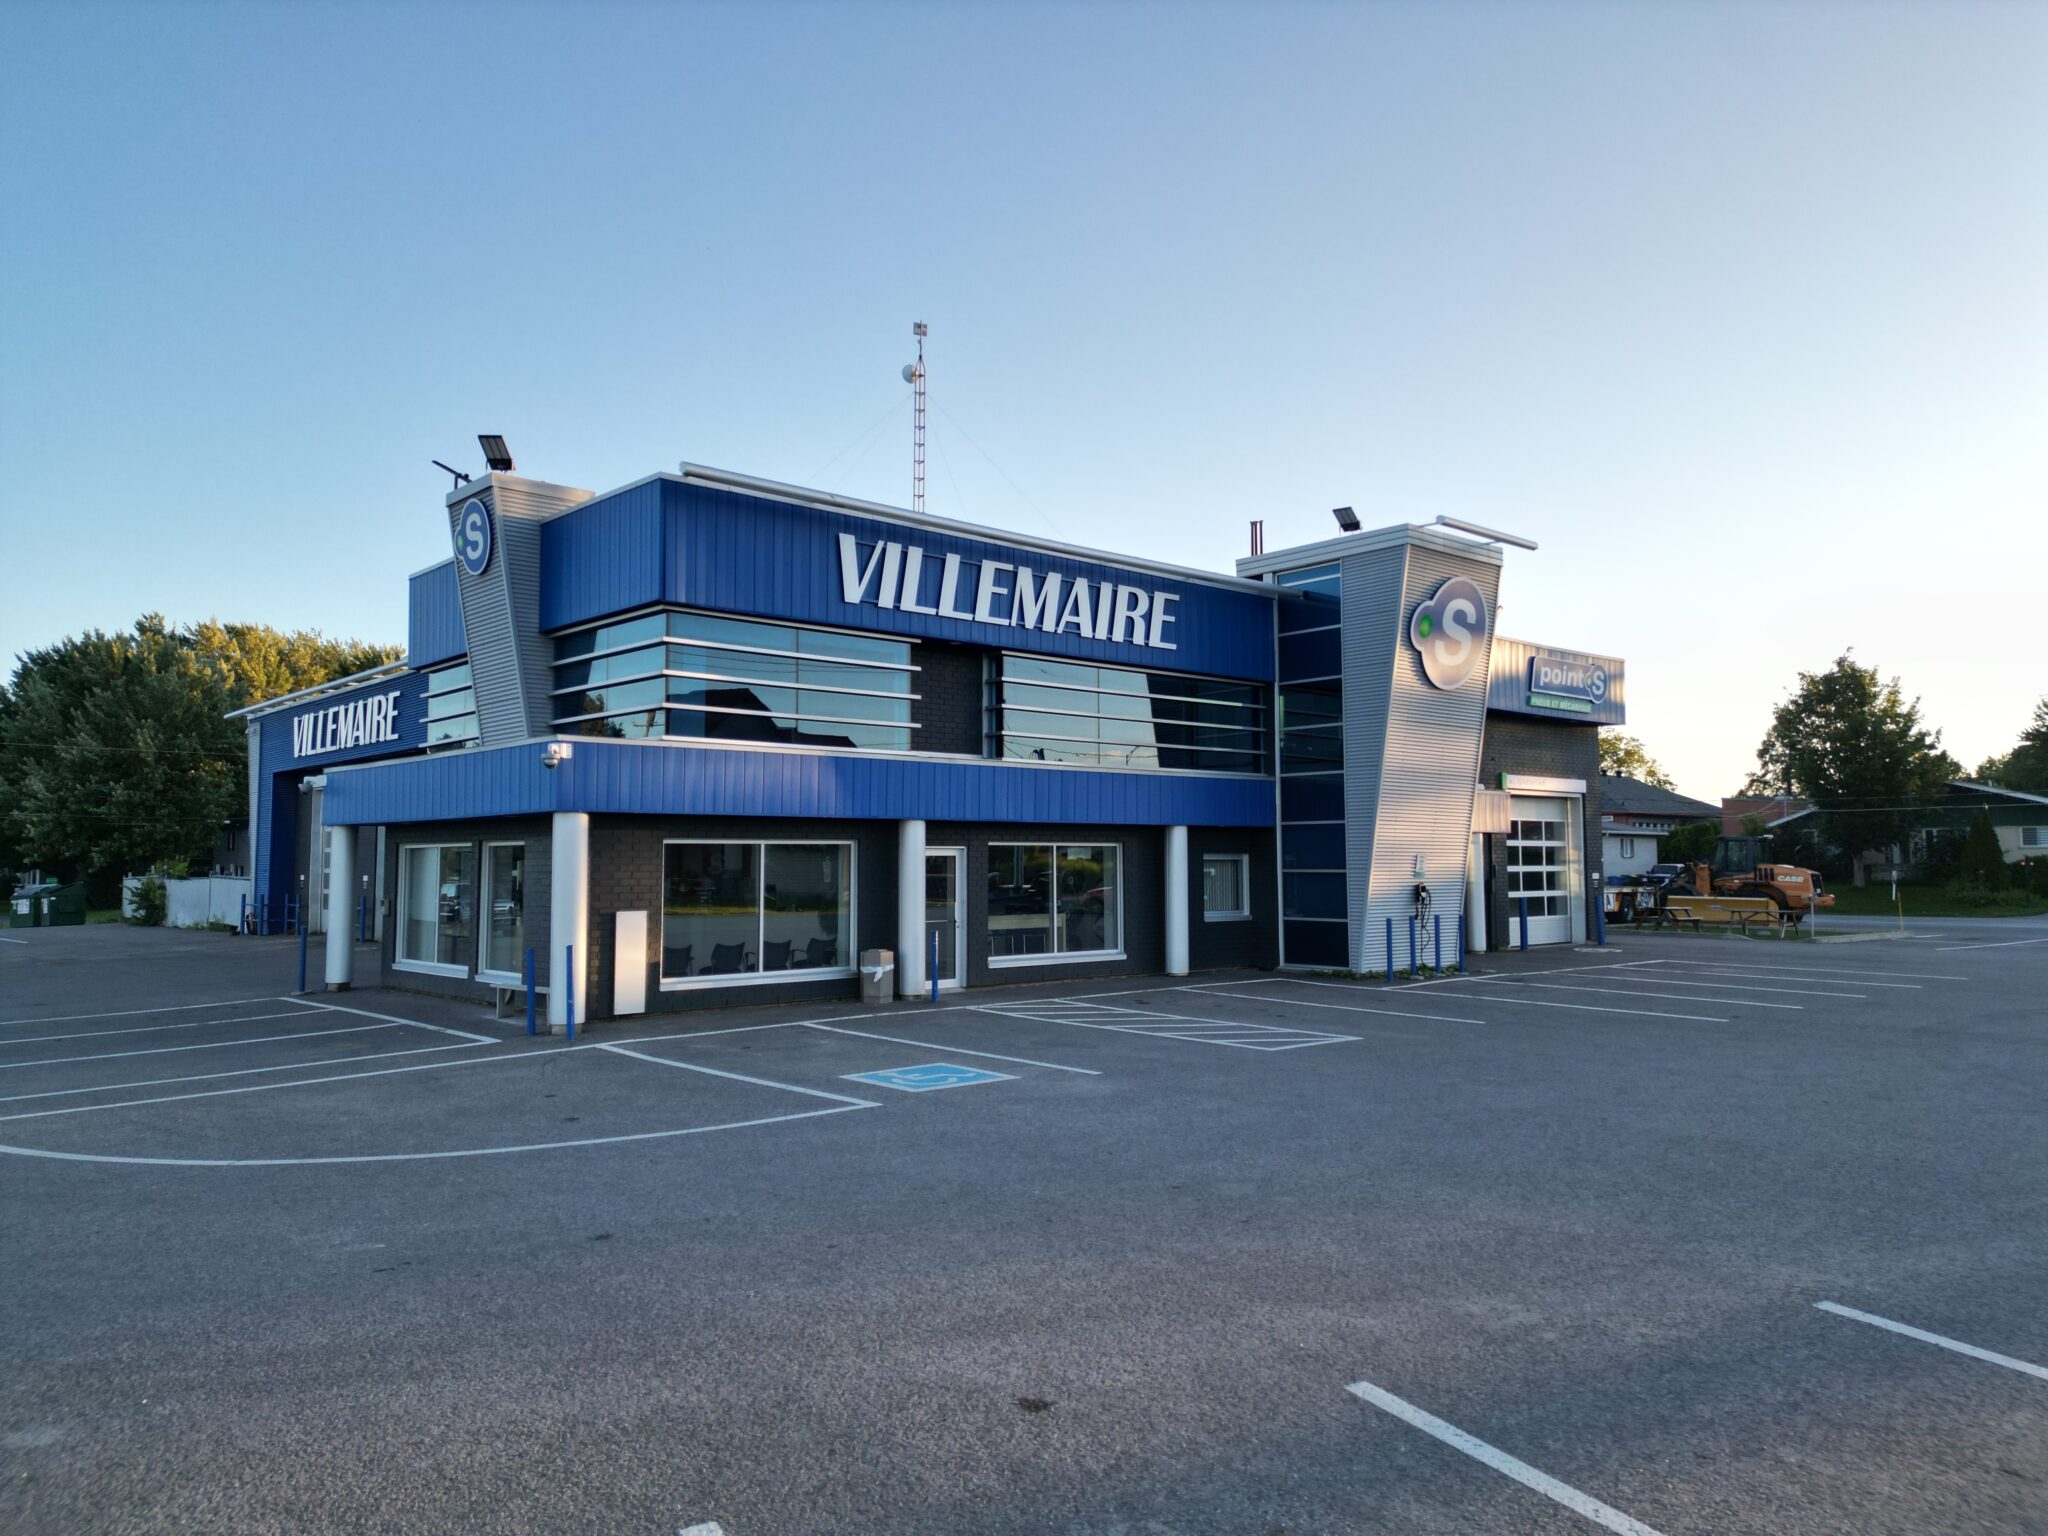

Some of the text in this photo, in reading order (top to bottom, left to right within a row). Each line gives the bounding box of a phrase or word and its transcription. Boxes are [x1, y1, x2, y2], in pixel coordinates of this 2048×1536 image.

[466, 513, 483, 560] S
[838, 532, 1180, 650] VILLEMAIRE
[1434, 598, 1477, 666] S
[1540, 665, 1585, 689] point
[293, 690, 401, 758] VILLEMAIRE
